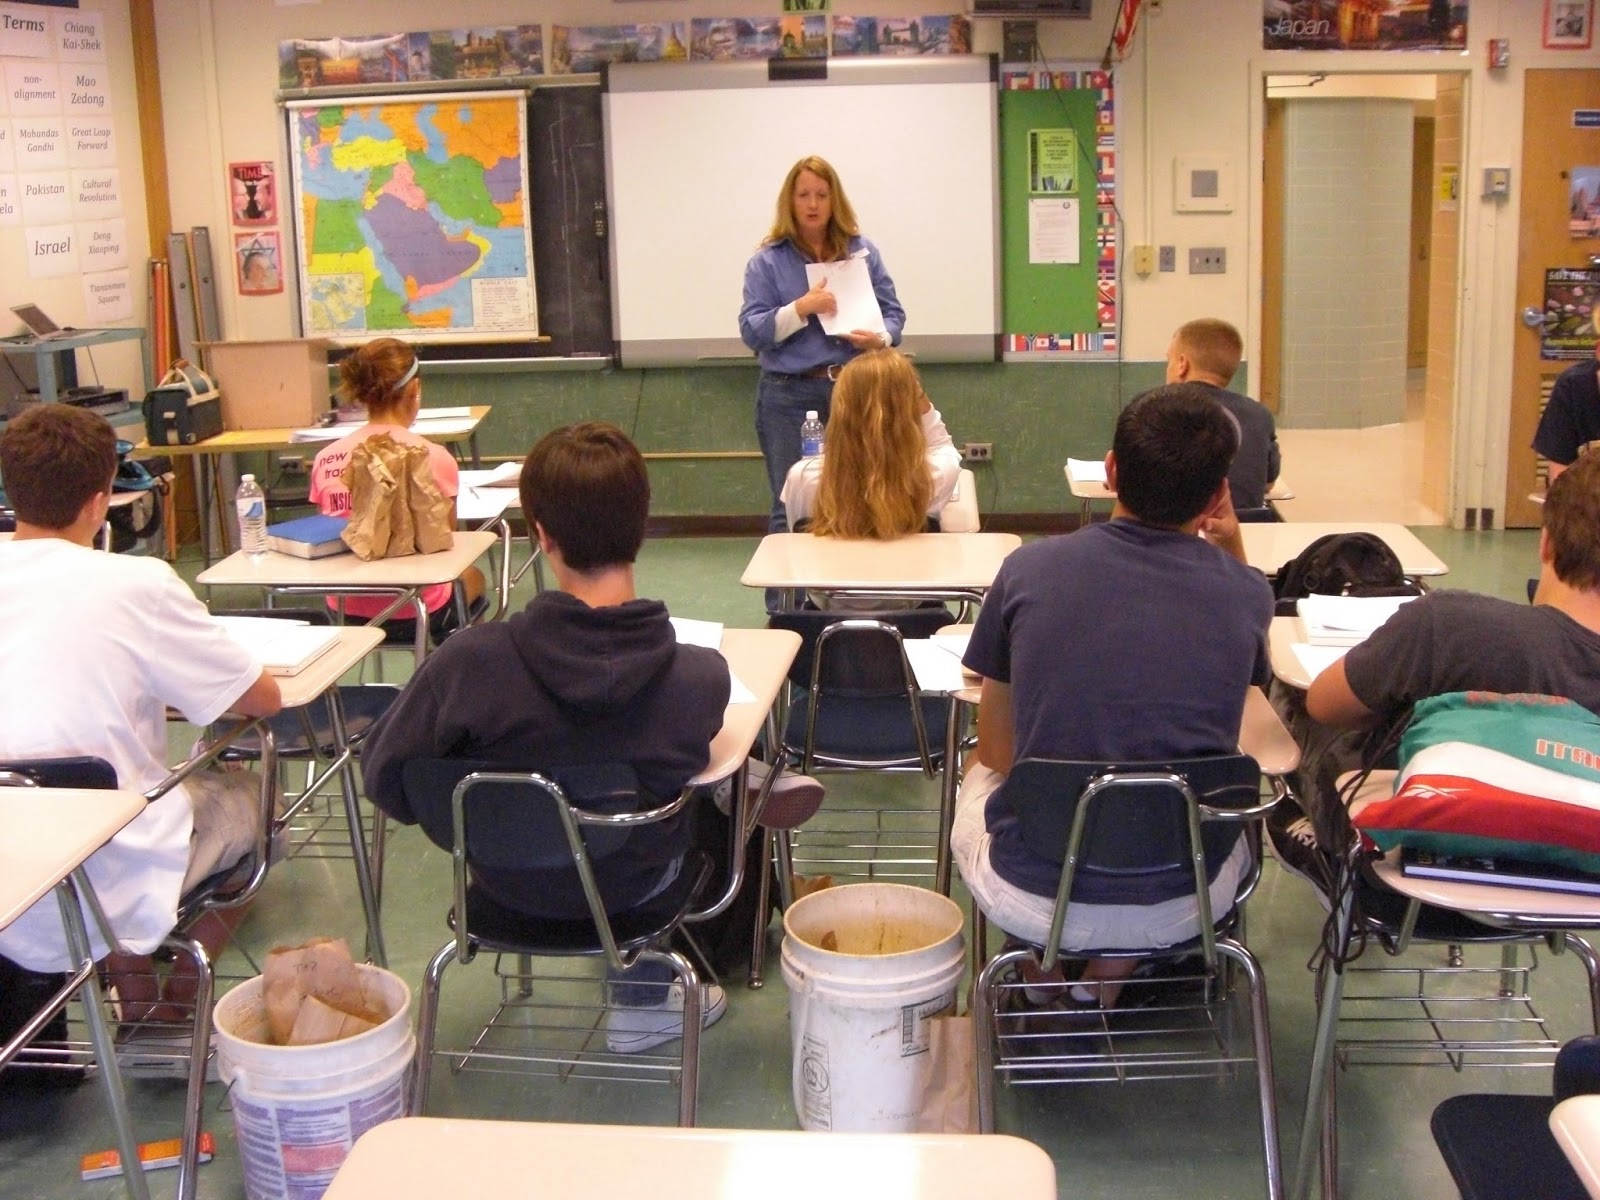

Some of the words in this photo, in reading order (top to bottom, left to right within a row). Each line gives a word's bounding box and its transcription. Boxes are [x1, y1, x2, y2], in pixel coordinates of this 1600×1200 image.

[3, 15, 44, 32] Terms
[64, 22, 95, 36] Chiang
[1269, 16, 1330, 39] Japan
[63, 38, 101, 50] Kai-Shek
[24, 76, 43, 84] non-
[76, 75, 96, 87] Mao
[14, 89, 56, 101] alignment
[71, 92, 104, 107] Zedong
[20, 129, 59, 139] Mohandas
[72, 128, 92, 138] Great
[93, 128, 111, 140] Leap
[27, 143, 54, 153] Gandhi
[77, 141, 108, 151] Forward
[238, 167, 262, 179] TIME
[26, 184, 65, 196] Pakistan
[82, 179, 112, 189] Cultural
[79, 193, 117, 202] Revolution
[93, 232, 111, 241] Deng
[34, 237, 71, 256] Israel
[88, 245, 120, 255] Xiaoping
[98, 296, 120, 305] Square
[320, 452, 348, 468] new
